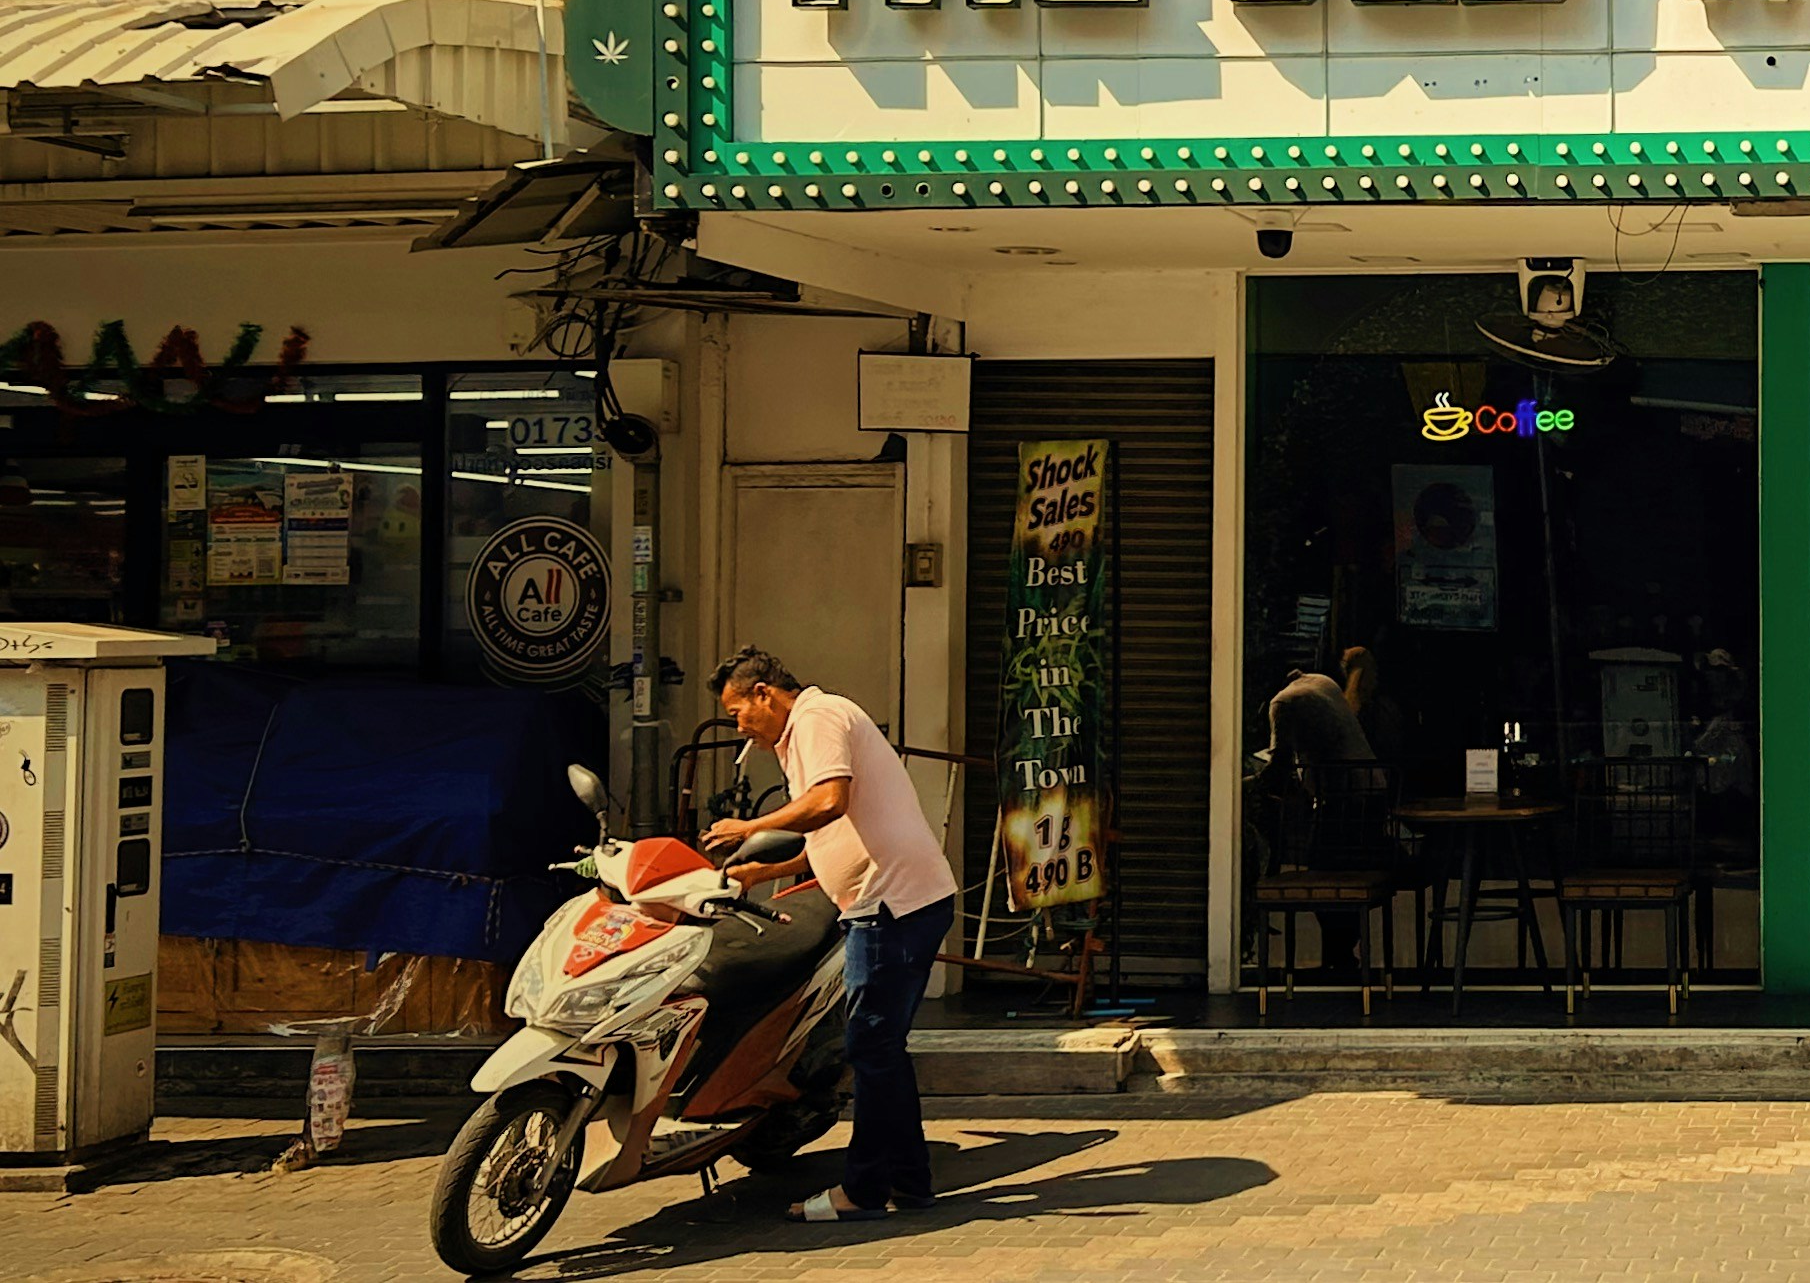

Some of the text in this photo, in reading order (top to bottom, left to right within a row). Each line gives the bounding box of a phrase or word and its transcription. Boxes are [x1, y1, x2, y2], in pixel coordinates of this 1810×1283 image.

[1475, 399, 1575, 438] Coffee
[1026, 444, 1099, 493] Shock
[1028, 487, 1095, 530] Sales
[487, 533, 537, 581] ALL
[1025, 557, 1089, 587] Best
[517, 568, 562, 605] All
[481, 603, 600, 658] ALL TIME GREAT TASTE
[1015, 607, 1091, 638] Price
[1039, 658, 1072, 687] in
[1024, 707, 1082, 738] The
[1026, 849, 1093, 894] 490 B
